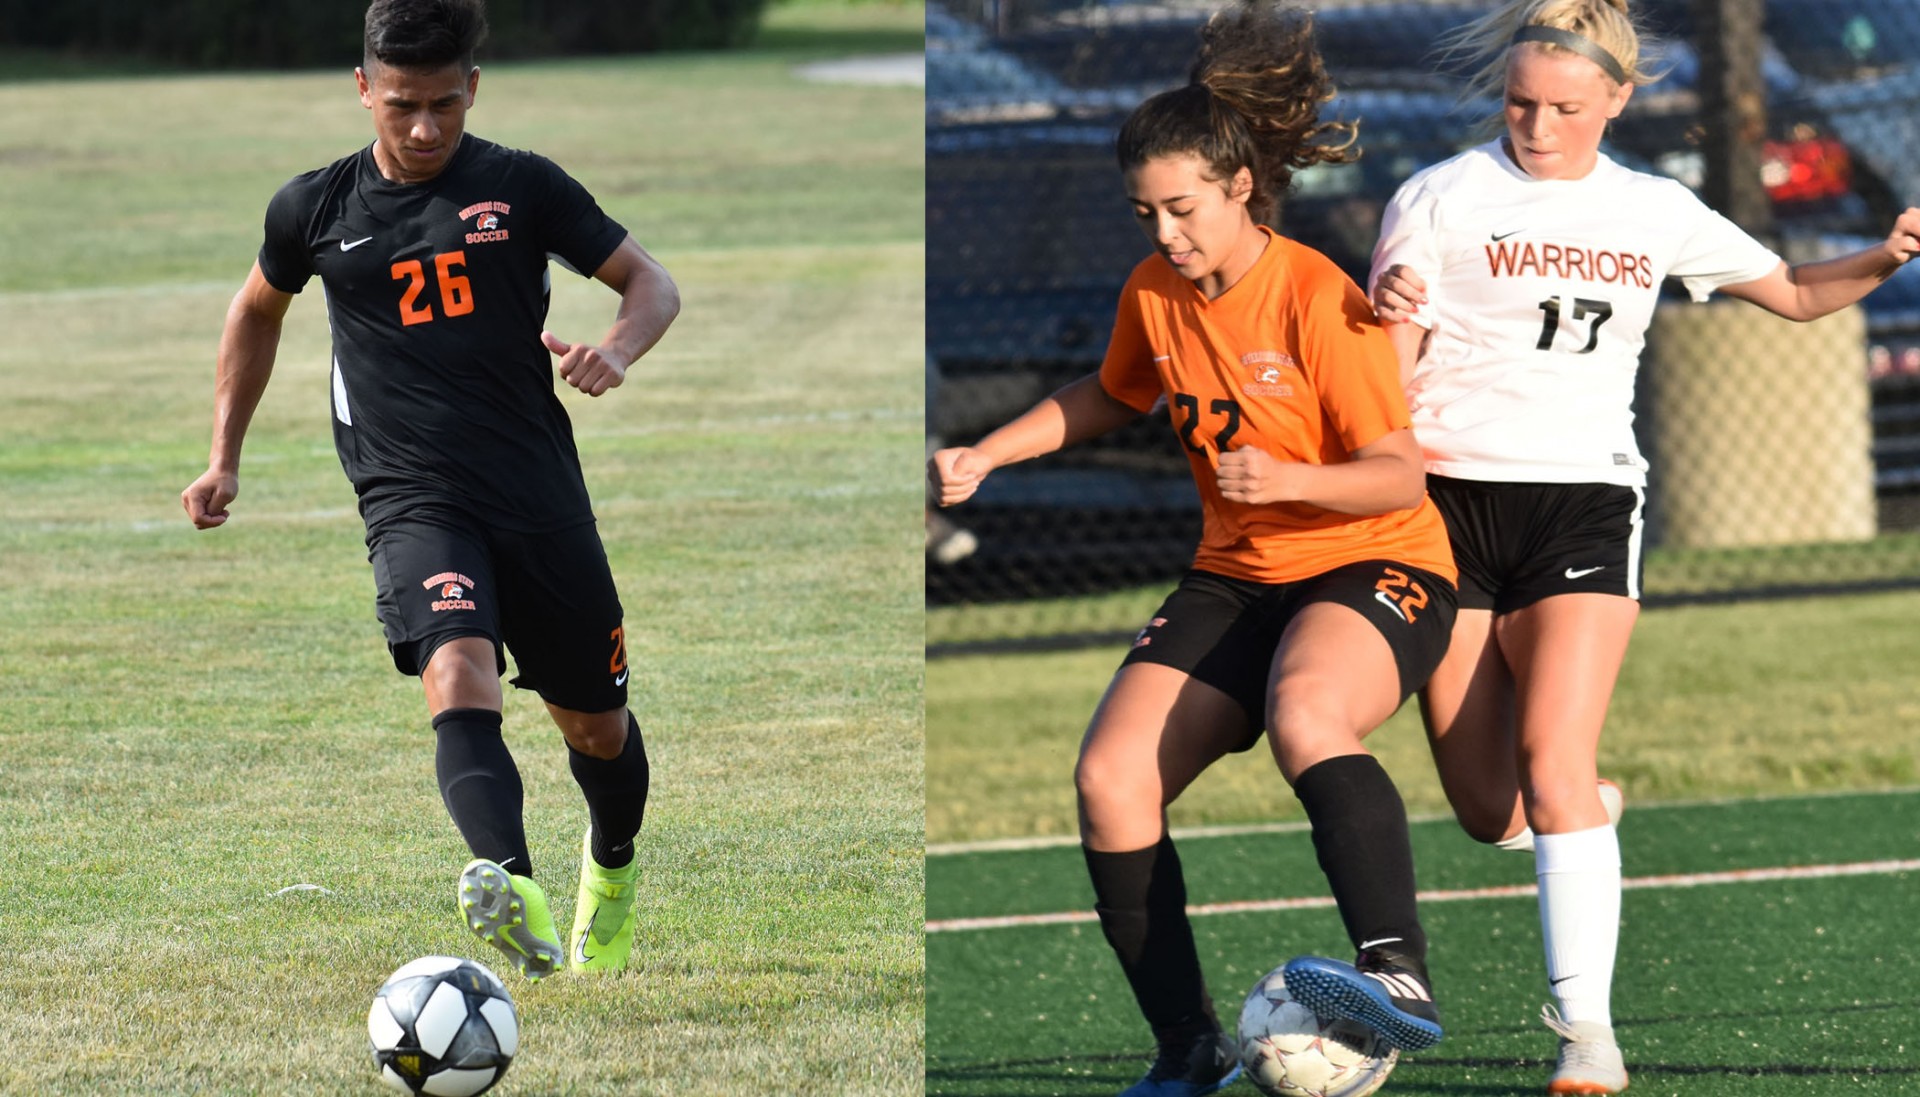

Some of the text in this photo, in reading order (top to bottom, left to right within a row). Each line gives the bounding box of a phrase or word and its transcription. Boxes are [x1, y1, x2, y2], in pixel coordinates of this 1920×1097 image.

[465, 229, 509, 244] SOCCER
[1485, 241, 1653, 289] WARRIORS
[391, 250, 475, 327] 26
[1535, 295, 1613, 354] 17
[1174, 392, 1240, 459] 22
[431, 599, 476, 612] SOCCER
[1374, 567, 1429, 625] 22
